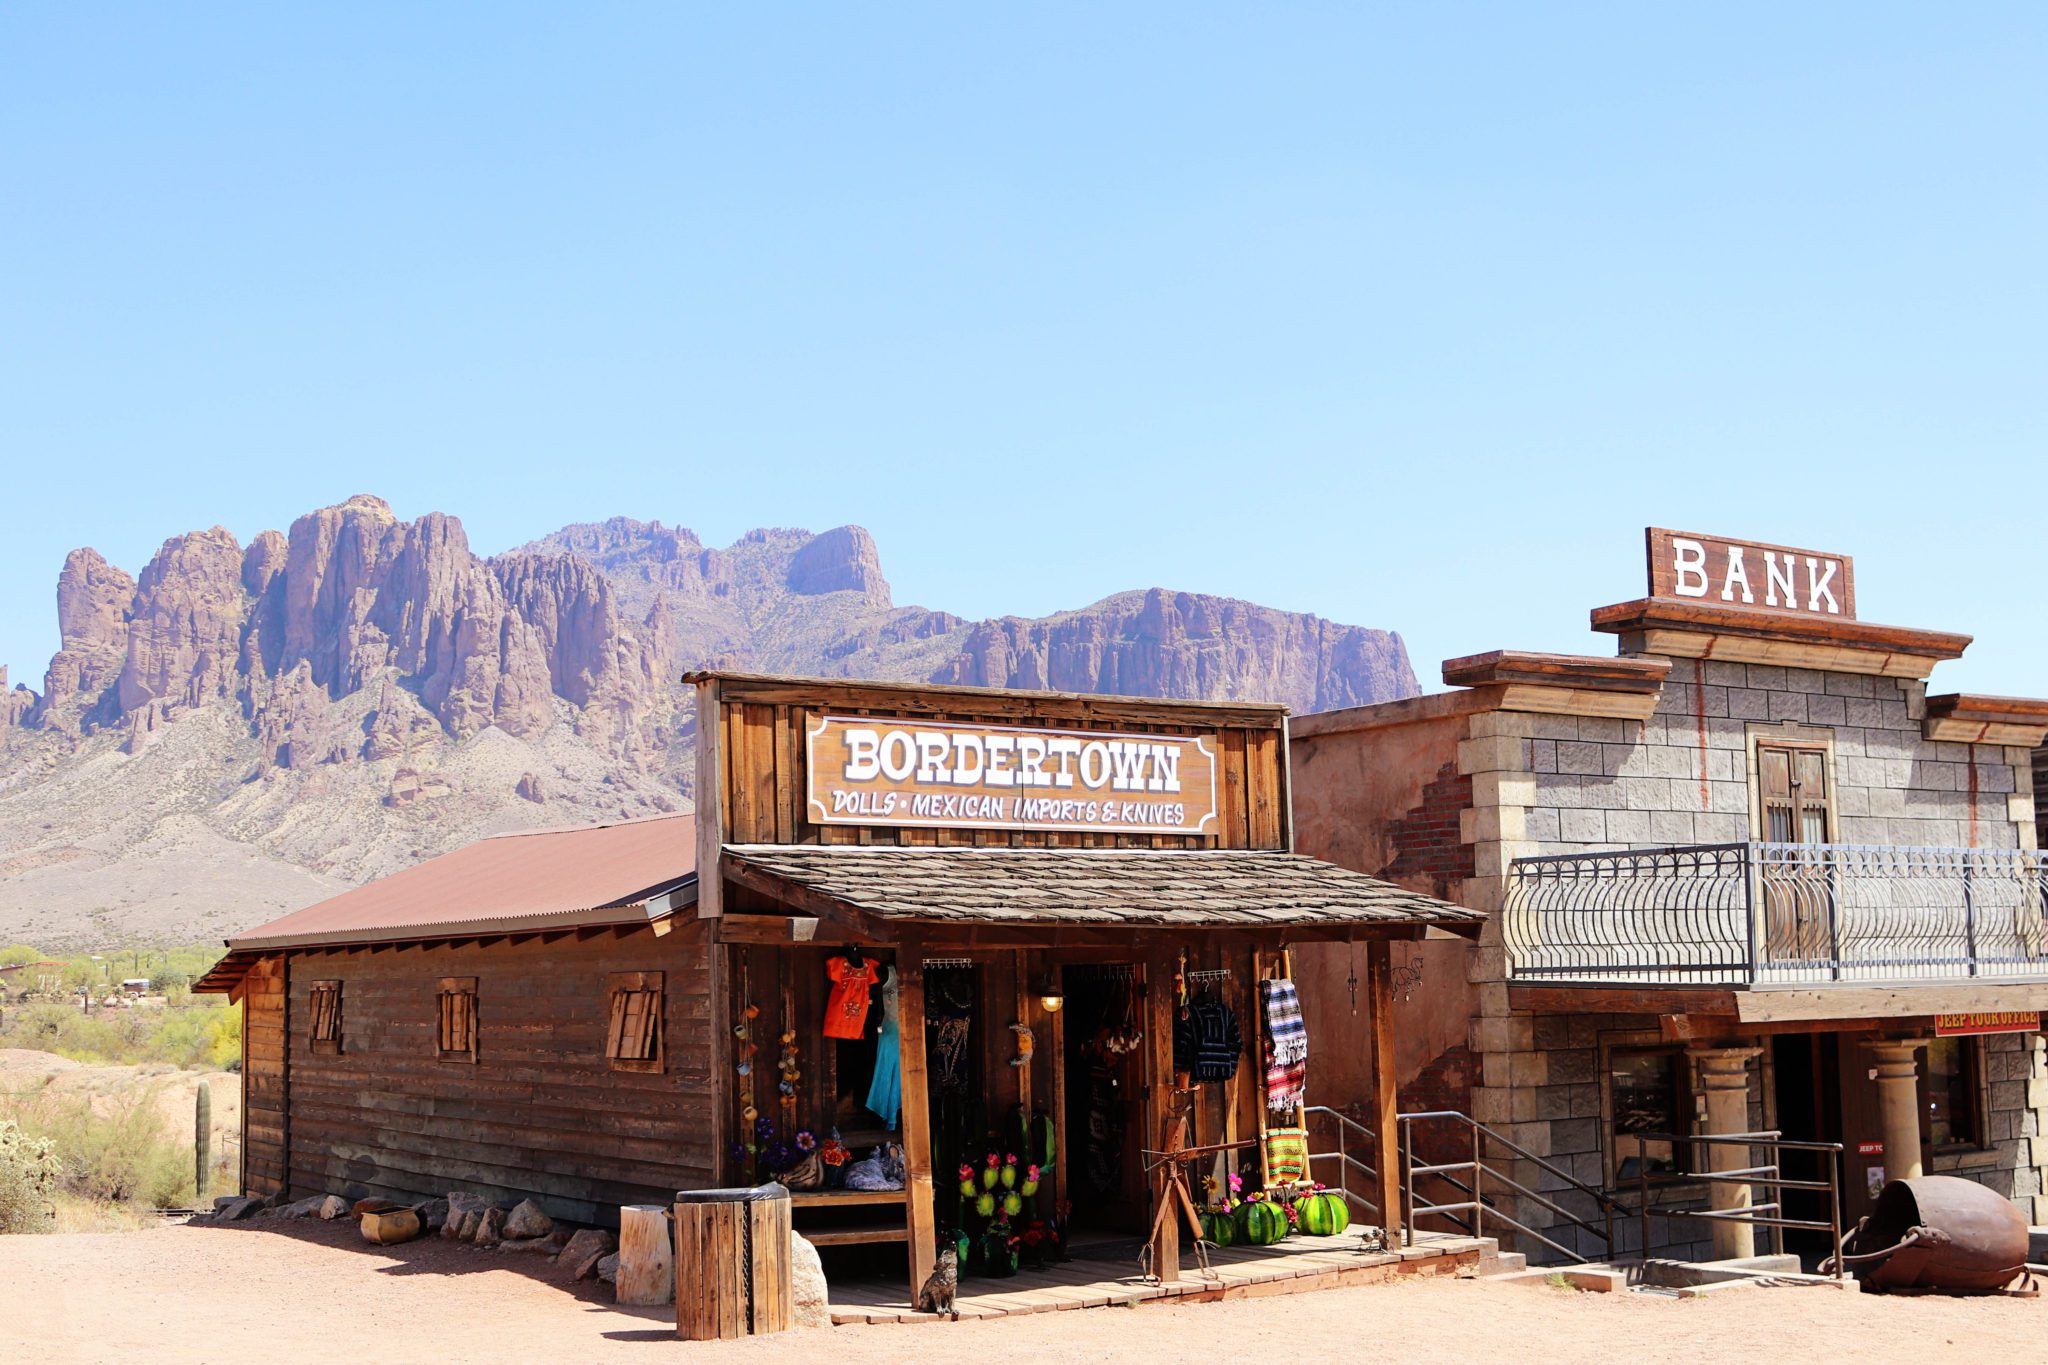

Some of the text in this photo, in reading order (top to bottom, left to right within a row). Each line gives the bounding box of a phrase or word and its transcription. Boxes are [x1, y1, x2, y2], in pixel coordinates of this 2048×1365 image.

[1672, 538, 1839, 614] BANK
[844, 729, 1181, 792] BORDERTOWN
[832, 789, 1185, 825] DOLLS MEXICAN IMPORTS & KNIVES
[1938, 1013, 1967, 1028] JEEP
